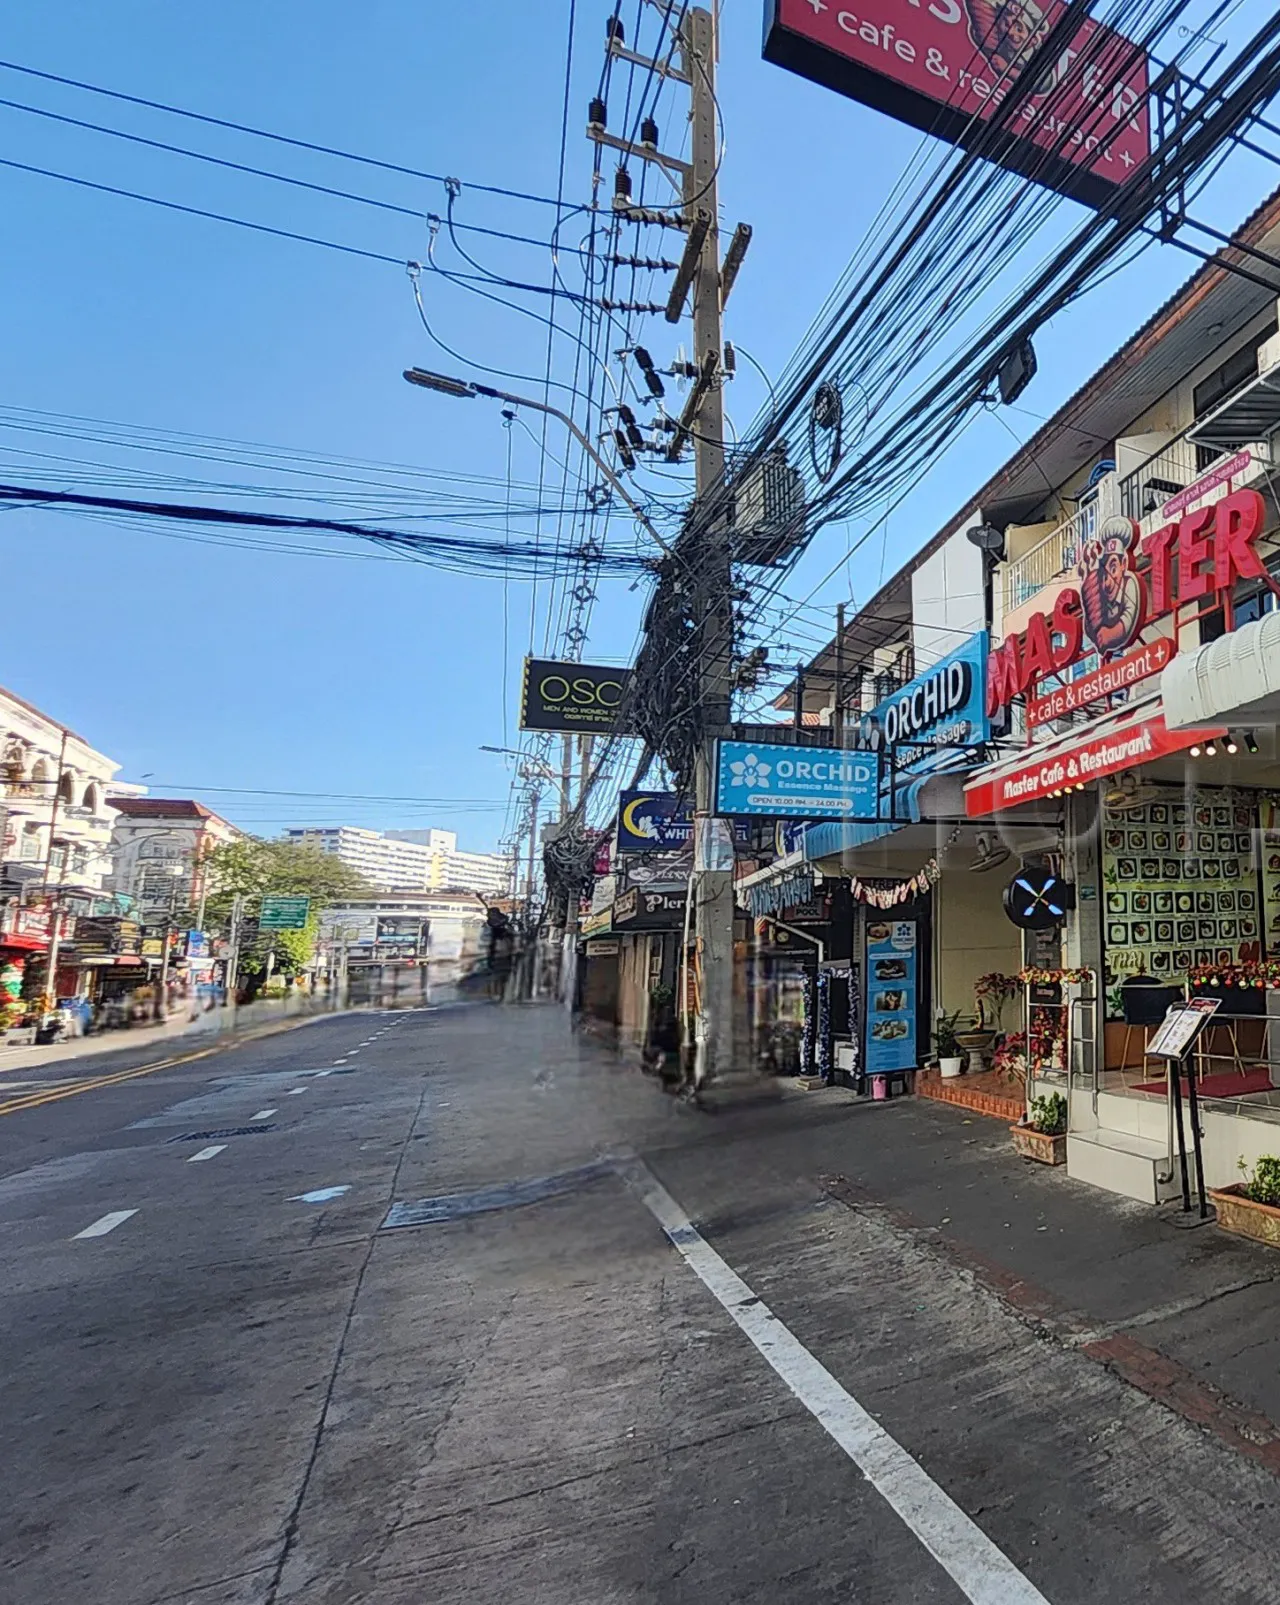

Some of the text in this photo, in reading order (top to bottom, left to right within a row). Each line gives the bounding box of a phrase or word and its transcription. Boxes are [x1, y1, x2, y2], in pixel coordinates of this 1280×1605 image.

[837, 9, 917, 64] cafe
[924, 47, 952, 82] &
[885, 660, 964, 746] ORCHID
[1037, 650, 1152, 721] cafe & restaurant
[776, 760, 871, 782] ORCHID
[777, 781, 867, 794] Essence Massage
[1003, 728, 1152, 799] Master Cafe & Restaurant
[1108, 951, 1145, 970] THAI
